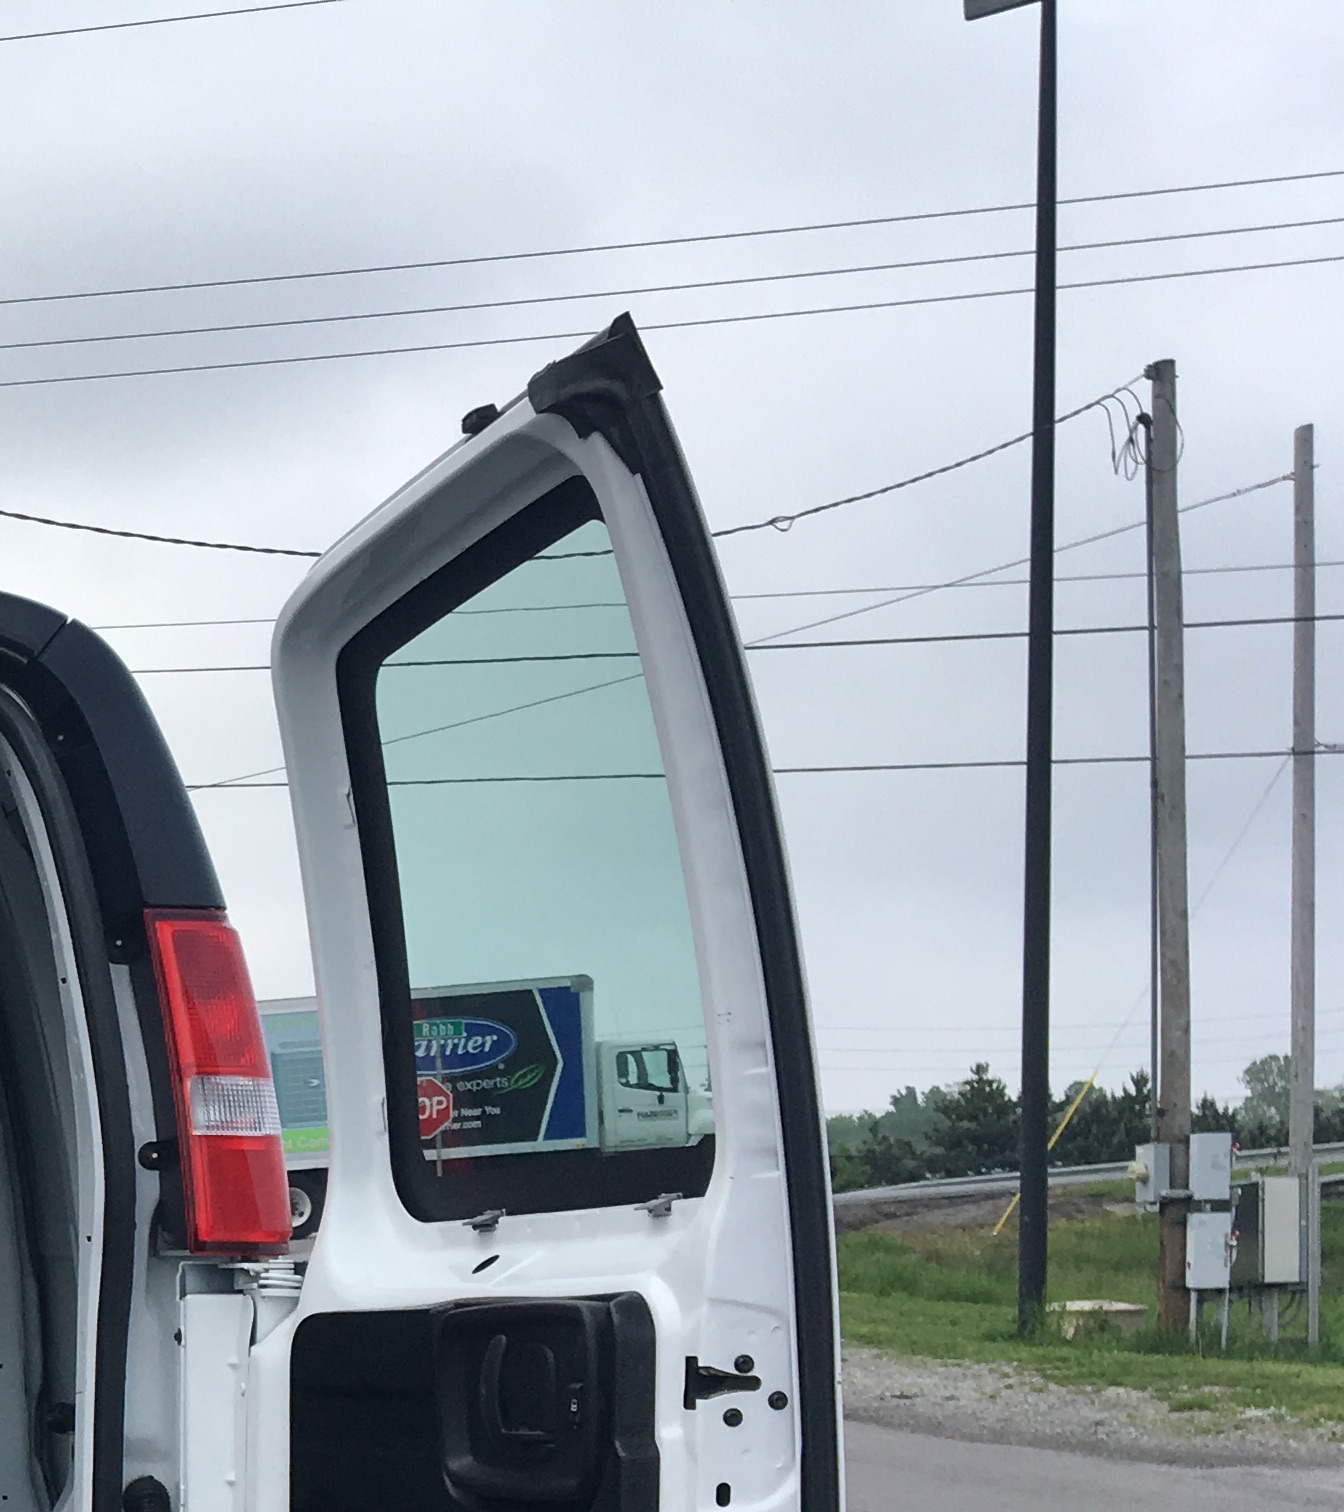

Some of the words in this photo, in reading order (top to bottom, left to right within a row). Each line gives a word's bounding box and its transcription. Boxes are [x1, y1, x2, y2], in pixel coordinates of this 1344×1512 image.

[422, 1023, 454, 1036] Robb
[415, 1034, 498, 1057] arrier
[457, 1077, 509, 1092] experts
[418, 1096, 448, 1119] OP
[484, 1105, 501, 1115] You
